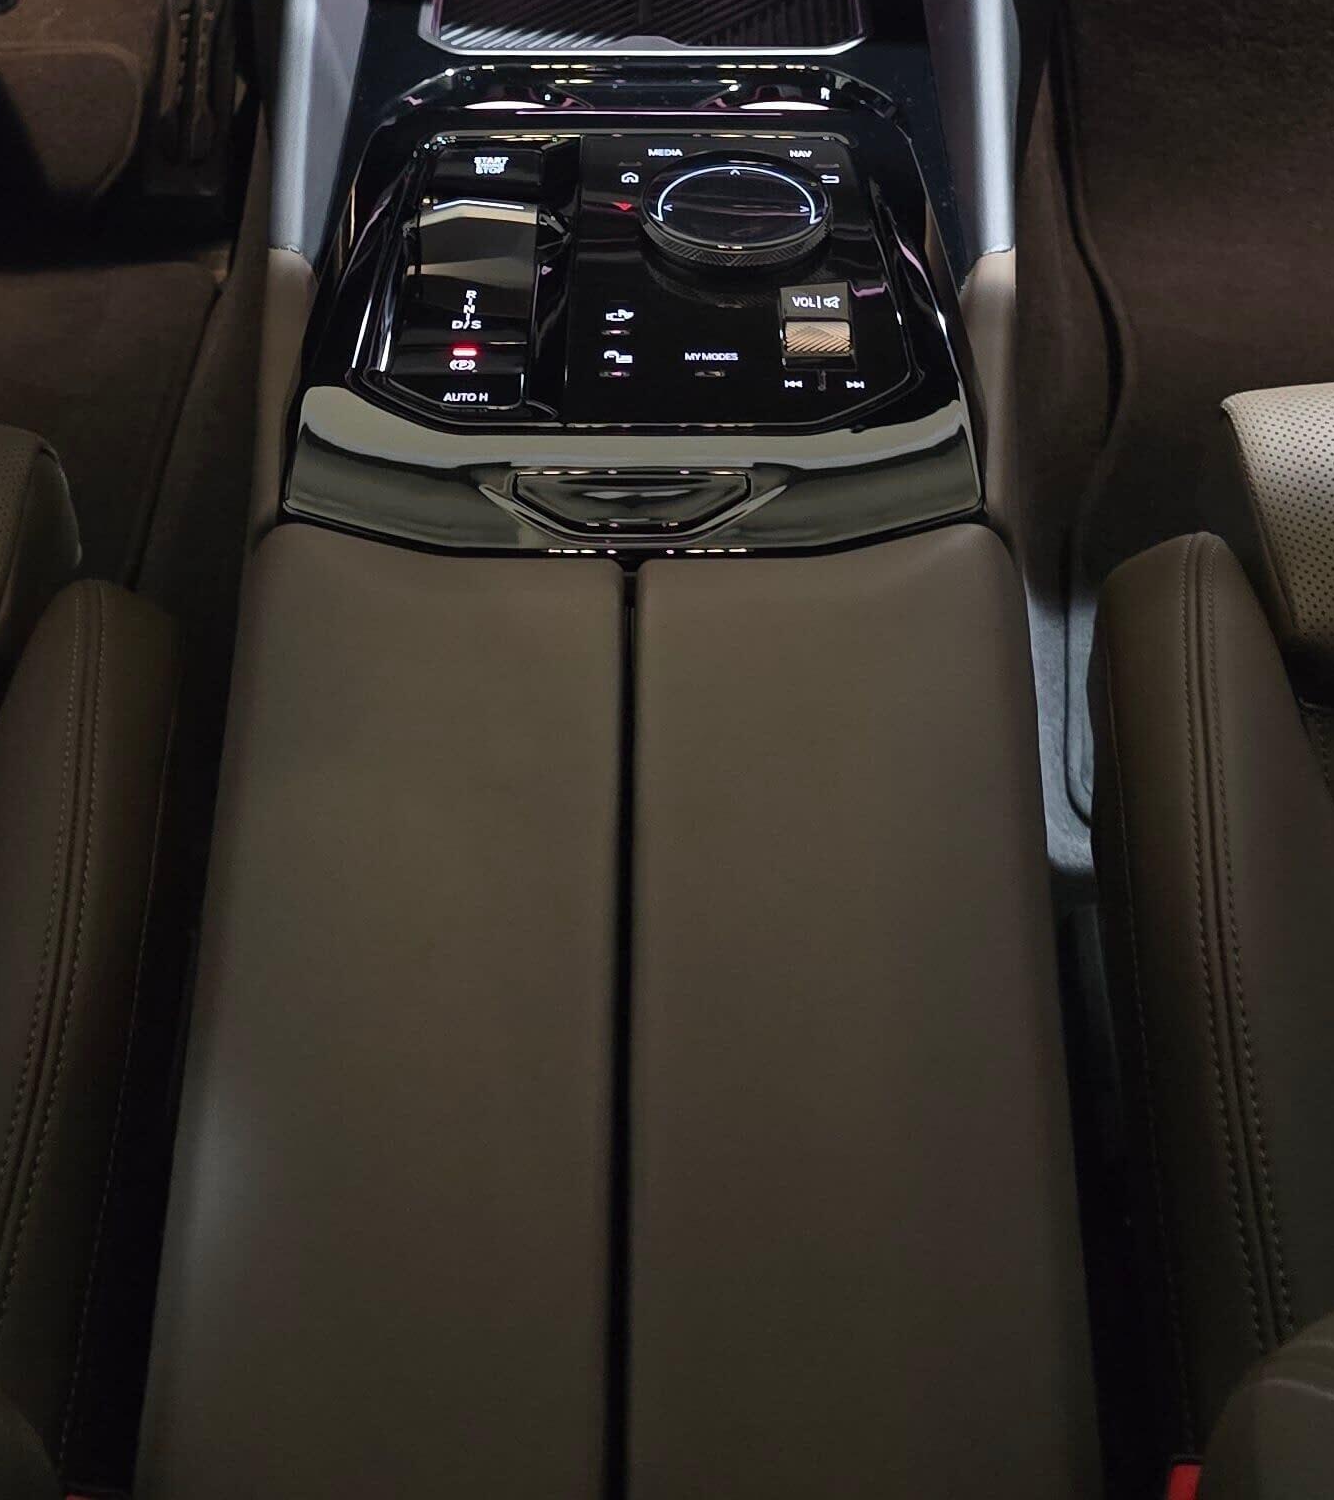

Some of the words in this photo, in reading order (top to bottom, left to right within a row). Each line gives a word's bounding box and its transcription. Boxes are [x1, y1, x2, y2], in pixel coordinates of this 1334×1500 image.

[647, 148, 683, 157] MEDIA
[789, 149, 812, 158] NAV
[474, 156, 509, 164] START
[475, 167, 505, 175] STOP
[465, 289, 477, 299] R
[791, 296, 815, 308] VOL
[463, 304, 475, 314] N
[684, 352, 701, 361] MY
[702, 352, 738, 361] MODES
[443, 392, 477, 402] AUTO
[478, 392, 489, 402] H
